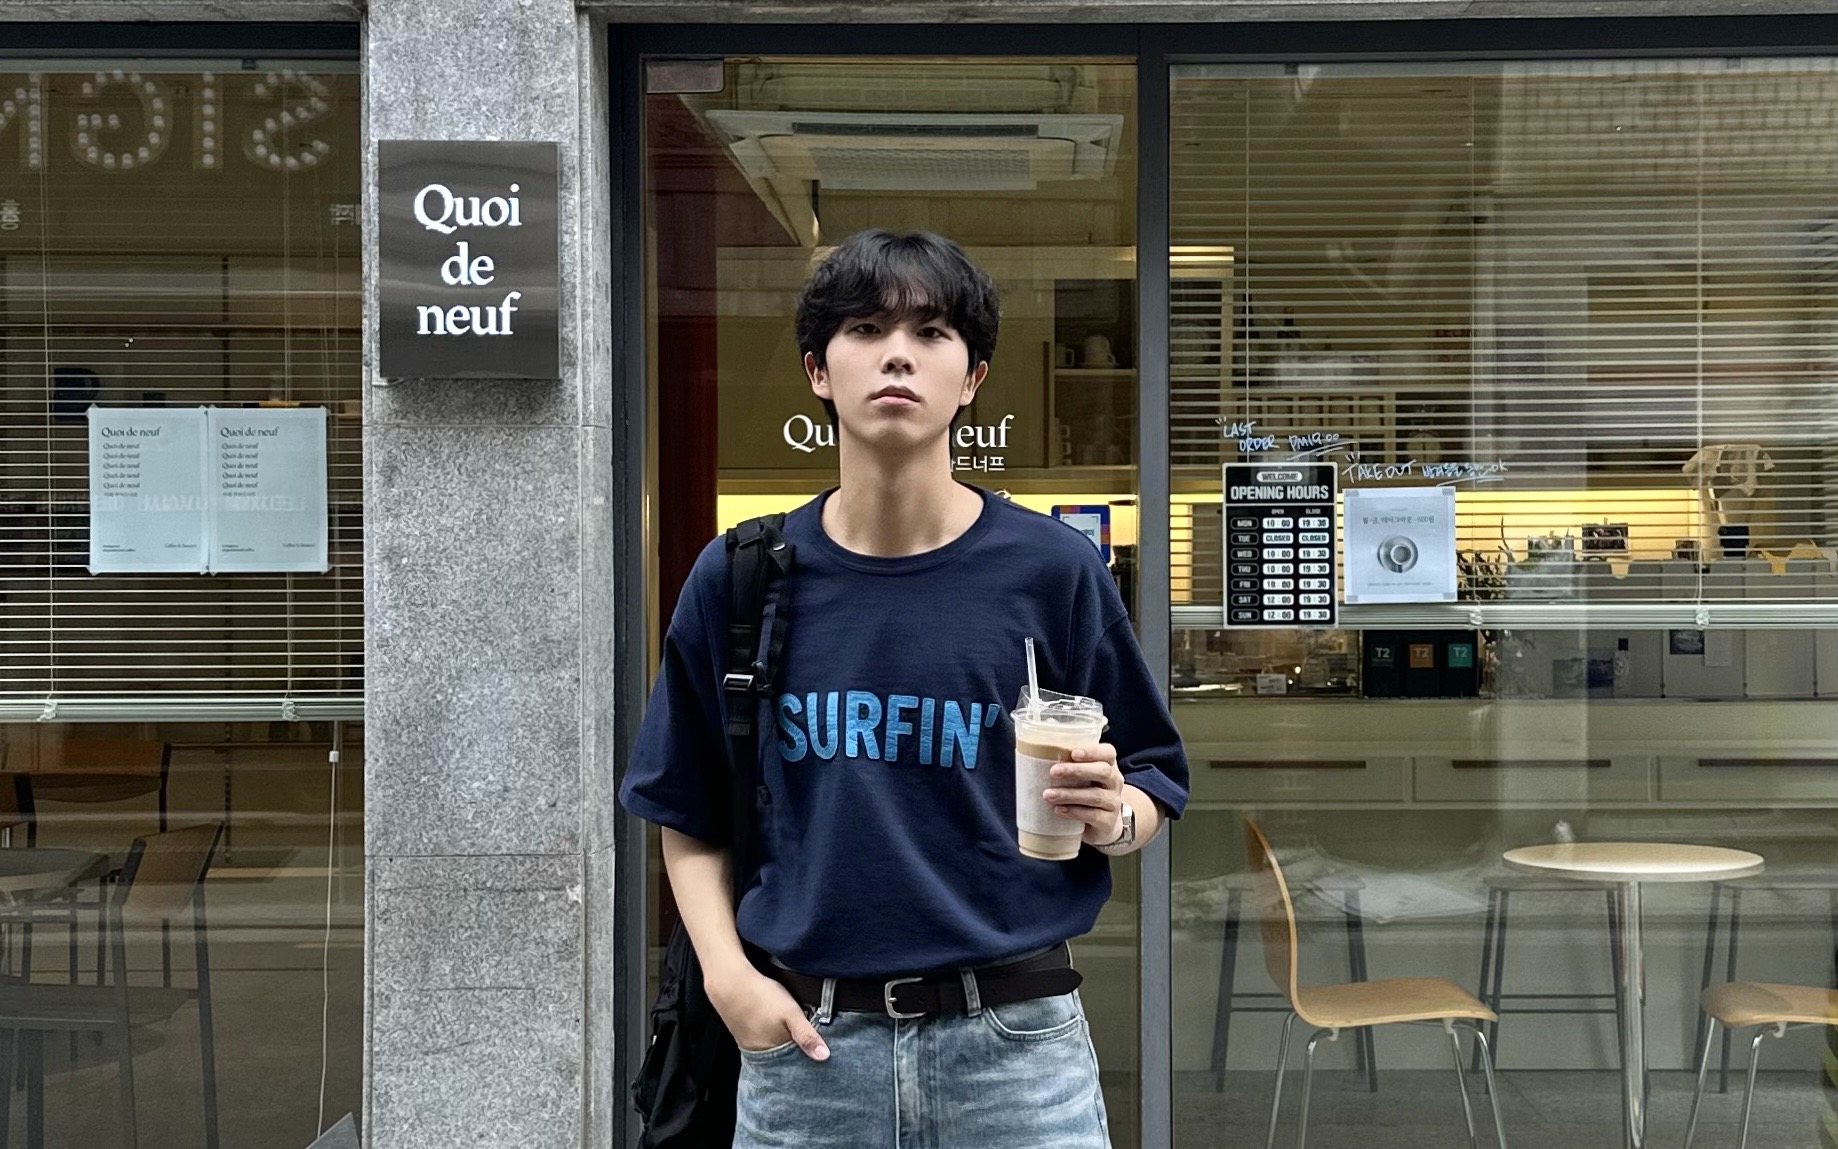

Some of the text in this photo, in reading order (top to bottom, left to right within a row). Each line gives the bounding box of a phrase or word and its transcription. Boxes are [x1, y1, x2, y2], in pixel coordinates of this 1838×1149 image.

[414, 183, 522, 234] Quoi
[441, 241, 495, 286] de
[416, 291, 522, 335] neuf
[101, 426, 161, 438] Quoi de neuf
[220, 426, 279, 438] Quoi de neuf
[783, 414, 1015, 453] Qu euf
[1223, 421, 1257, 438] LAST
[1239, 434, 1280, 452] ORDER
[1261, 473, 1299, 481] WELCOME
[1341, 463, 1383, 483] TAKE
[1385, 459, 1416, 478] OUT
[1230, 485, 1329, 500] OPENING HOURS
[1237, 550, 1252, 558] WED
[1376, 647, 1390, 658] T2
[1414, 647, 1429, 658] T2
[1453, 647, 1467, 658] T2
[778, 690, 1000, 769] SURFIN'
